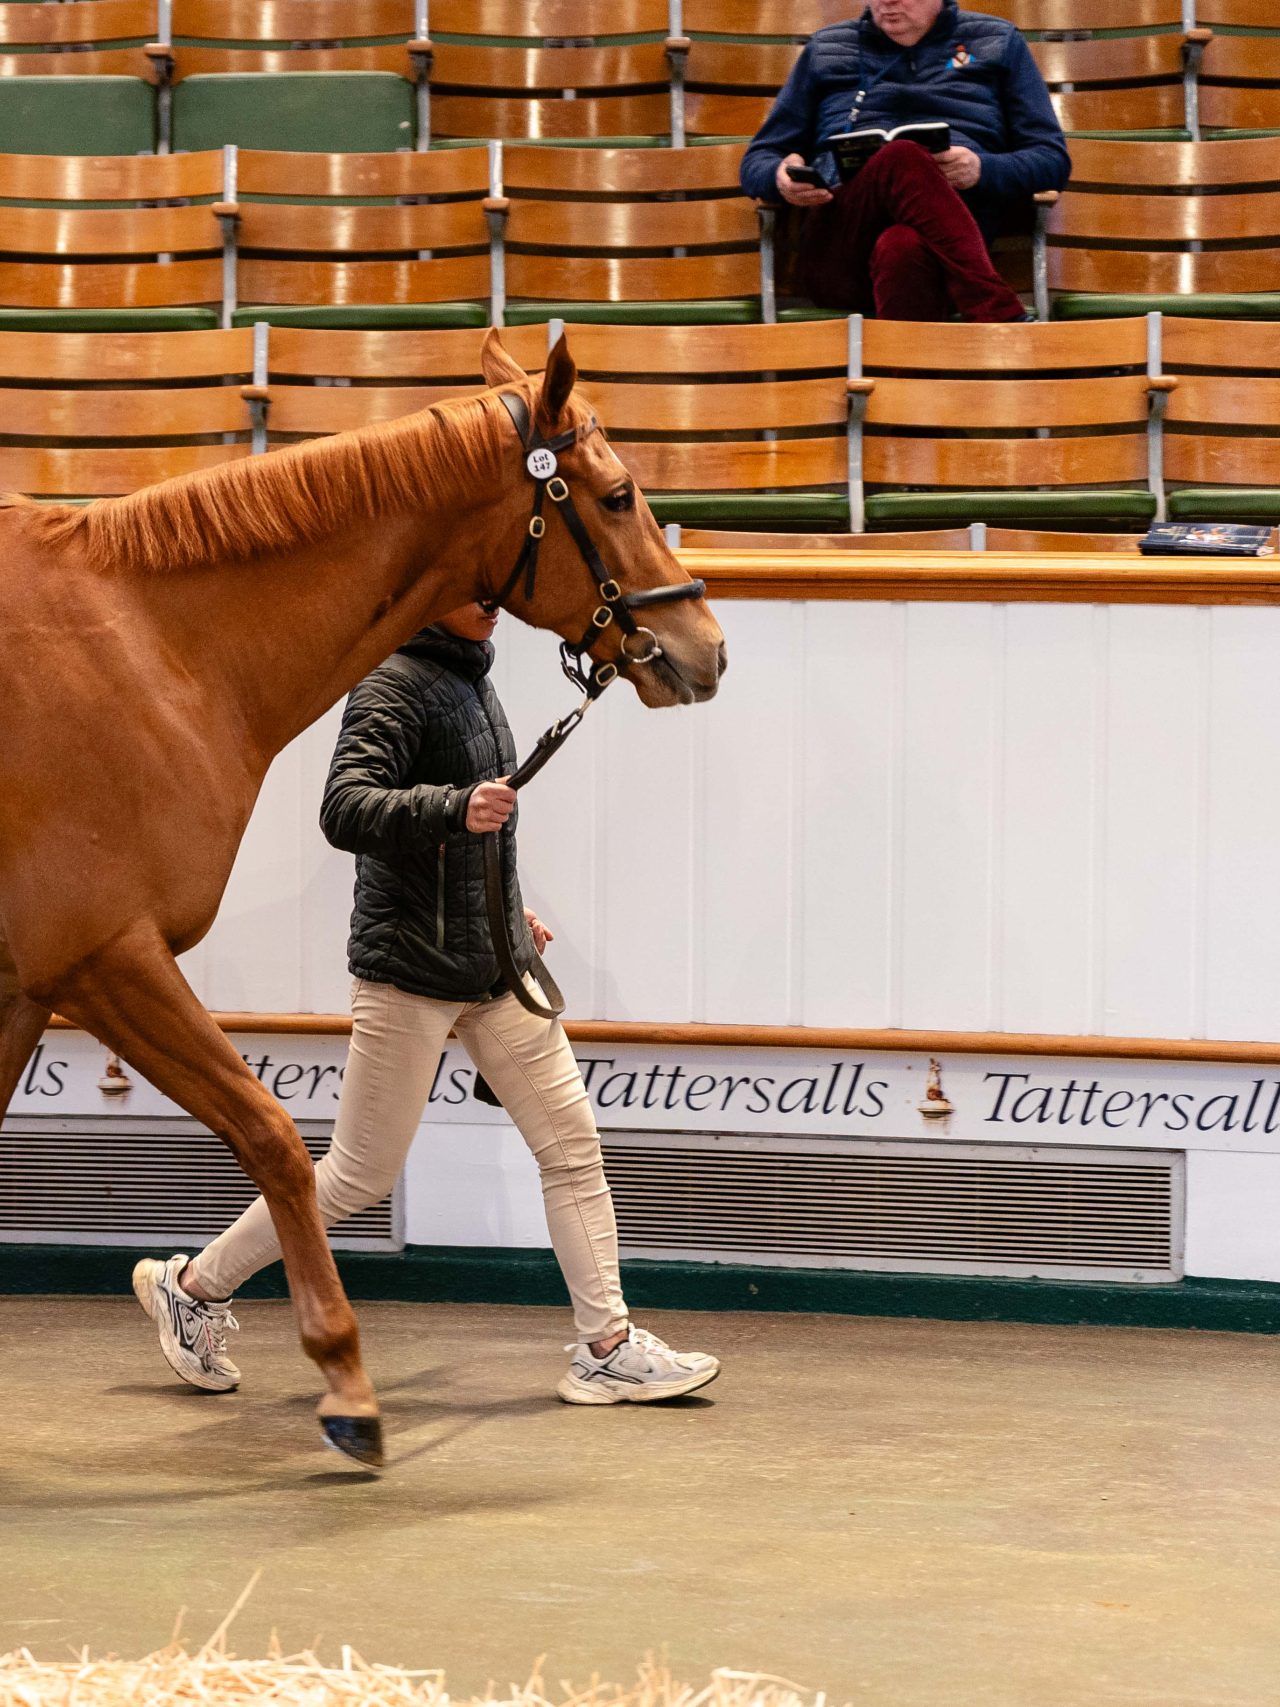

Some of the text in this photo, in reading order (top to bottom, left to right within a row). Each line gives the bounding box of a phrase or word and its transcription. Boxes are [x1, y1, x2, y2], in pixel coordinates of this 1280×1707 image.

[532, 453, 549, 463] Lot
[534, 462, 551, 472] 147
[575, 1058, 889, 1118] Tattersalls
